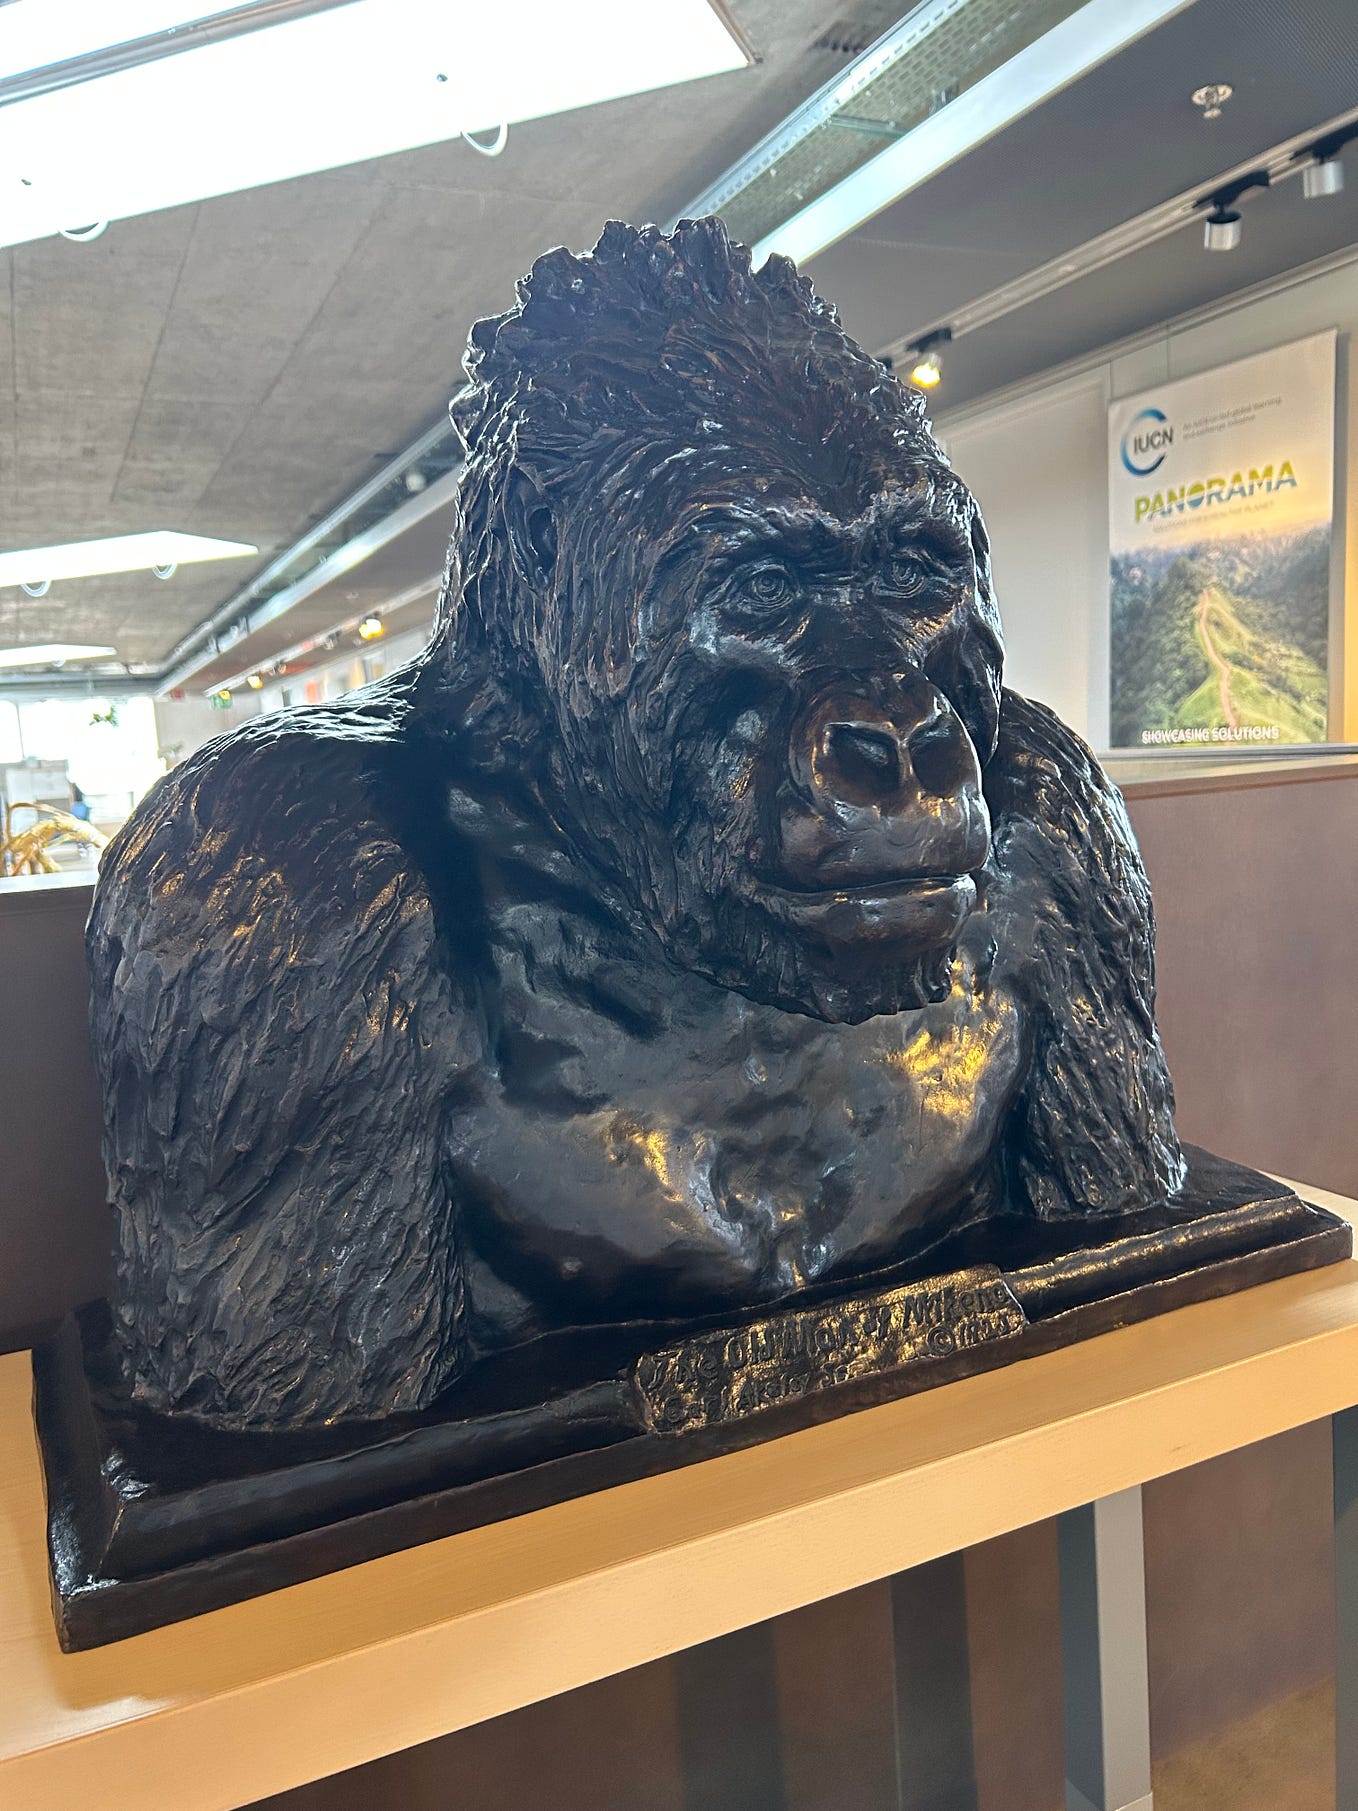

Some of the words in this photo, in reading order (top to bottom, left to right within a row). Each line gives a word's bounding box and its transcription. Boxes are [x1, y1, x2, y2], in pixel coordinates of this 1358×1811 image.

[1133, 428, 1174, 454] IUCN
[1135, 460, 1297, 523] PANORAMA
[1141, 728, 1210, 744] SHOWCASING
[1211, 725, 1280, 742] SOLUTIONS
[649, 1350, 718, 1389] The
[726, 1327, 775, 1367] Old
[783, 1317, 858, 1357] Man
[862, 1305, 892, 1341] of
[903, 1285, 1008, 1327] Mikeno
[663, 1382, 727, 1416] Carl
[734, 1371, 810, 1408] Akeley
